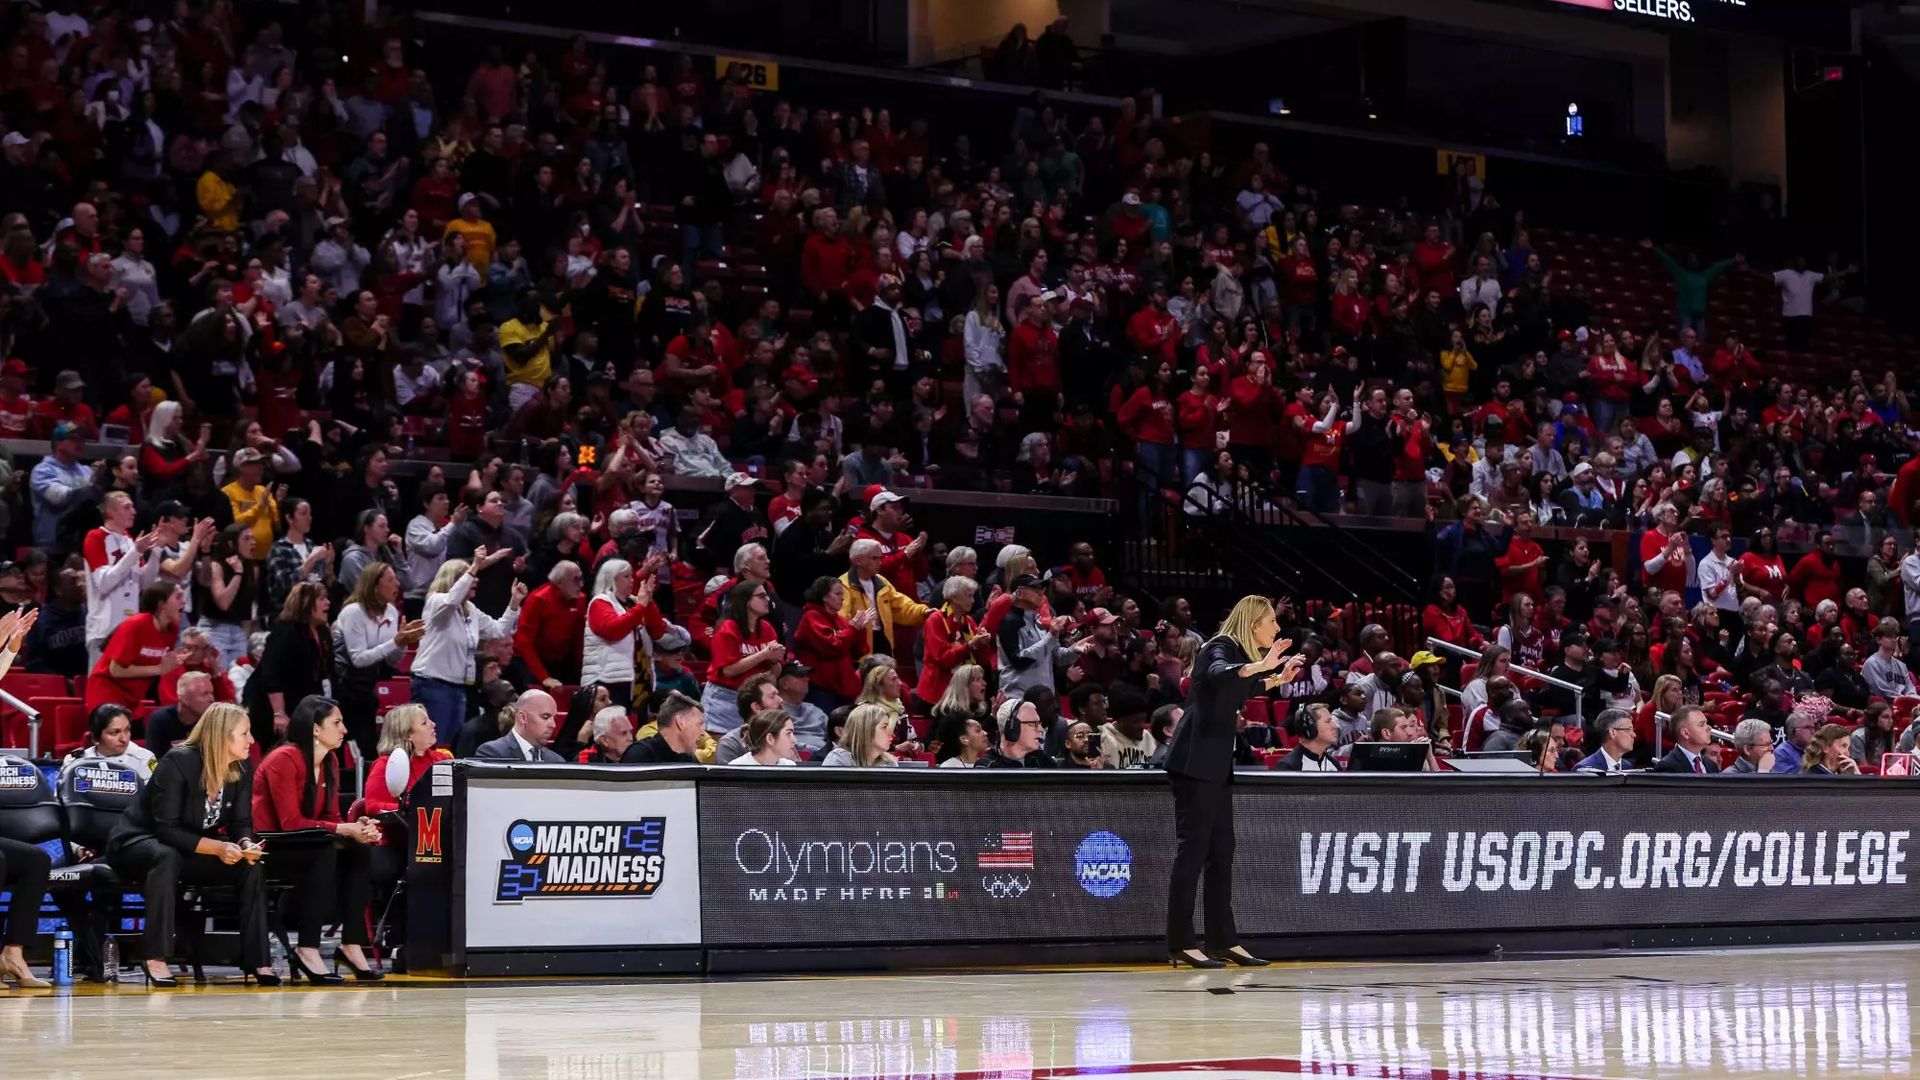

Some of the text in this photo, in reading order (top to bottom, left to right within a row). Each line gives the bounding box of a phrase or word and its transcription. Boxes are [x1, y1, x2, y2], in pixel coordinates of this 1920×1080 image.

[1613, 0, 1695, 23] SELLERS.
[730, 61, 767, 87] 26
[86, 769, 120, 780] MARCH
[92, 780, 136, 791] MADNESS
[416, 806, 443, 856] M
[513, 836, 534, 845] NCAA
[535, 825, 621, 854] MARCH
[546, 855, 662, 884] MADNESS
[735, 828, 958, 885] Olympians
[1300, 830, 1910, 894] VISIT USOPC.ORG/COLLEGE
[1081, 864, 1131, 880] NCAA
